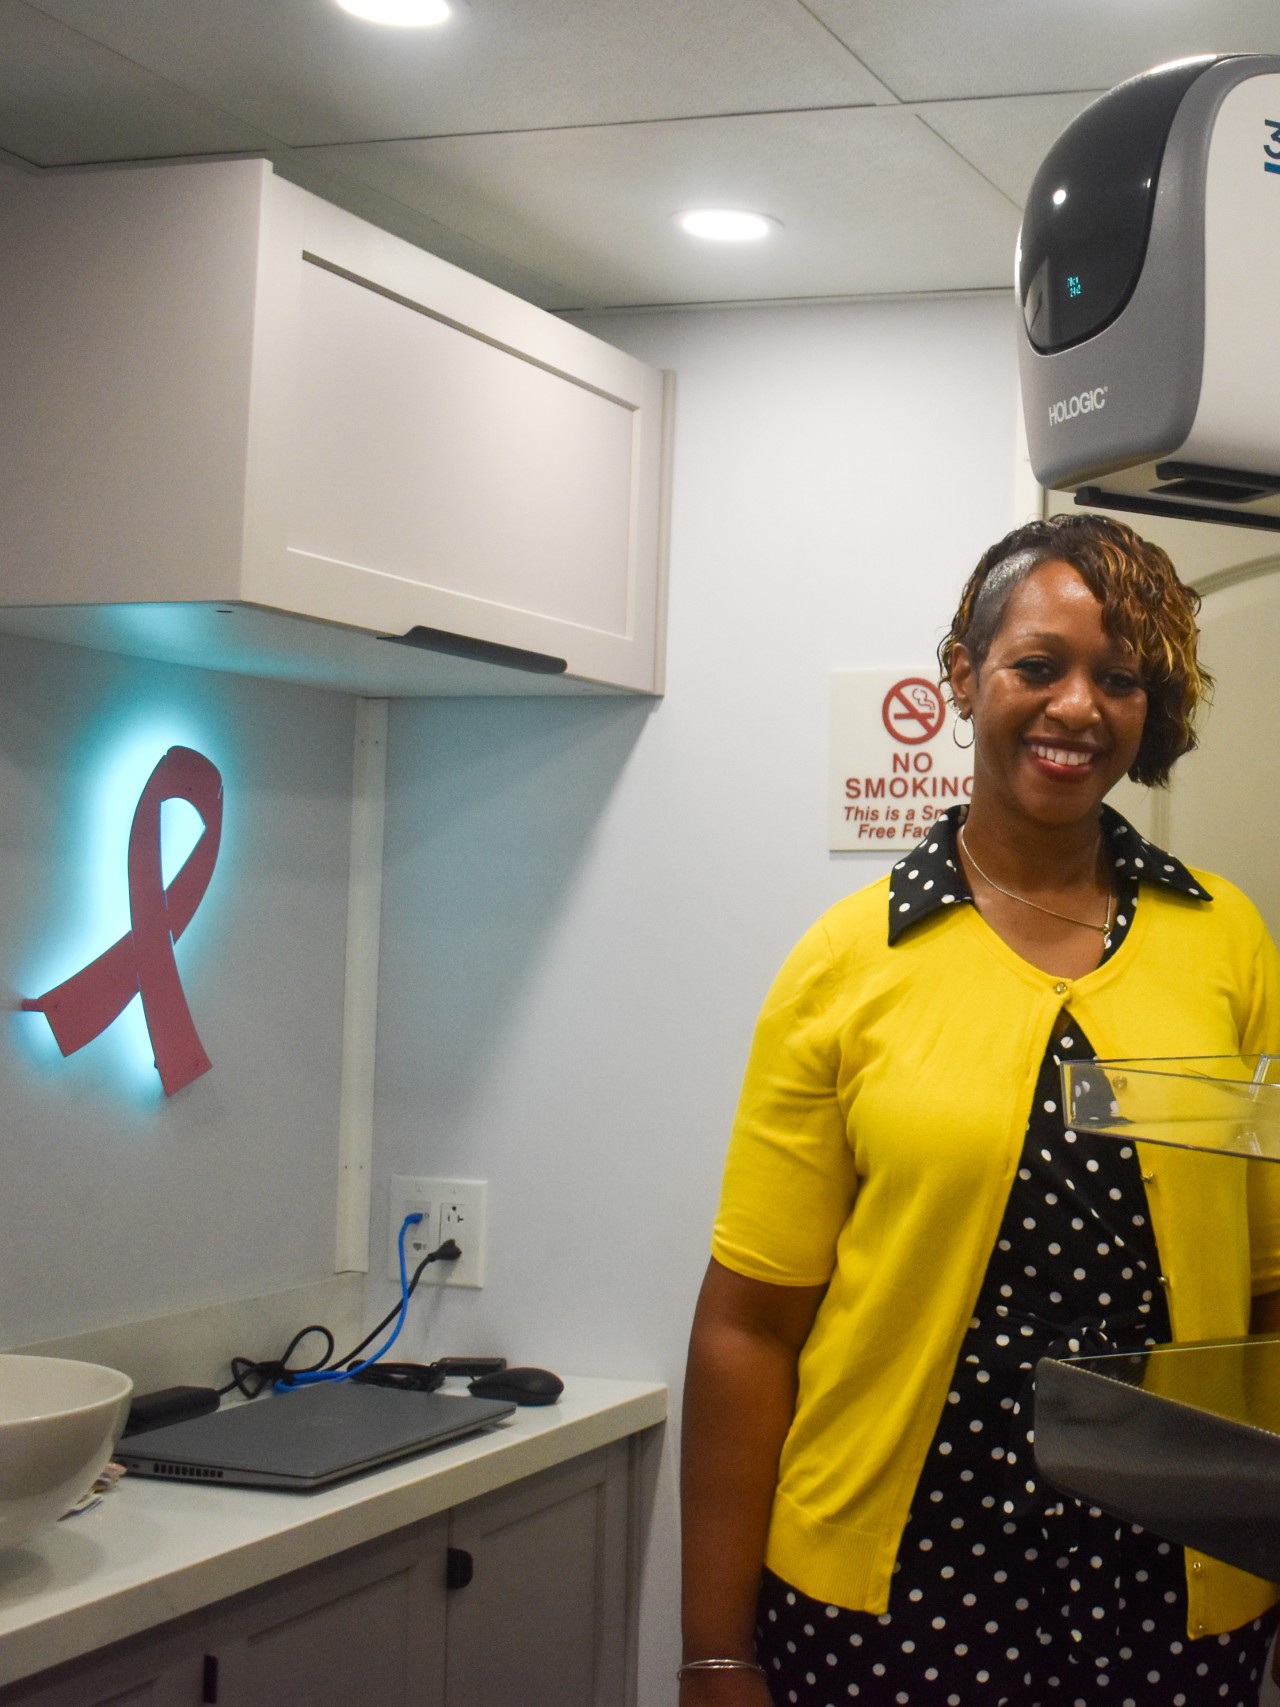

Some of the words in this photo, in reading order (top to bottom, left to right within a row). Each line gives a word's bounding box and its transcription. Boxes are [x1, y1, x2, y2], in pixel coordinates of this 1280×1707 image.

[1048, 387, 1106, 427] HOLOGIC
[892, 751, 933, 773] NO
[844, 805, 879, 821] This
[885, 805, 900, 821] is
[905, 808, 916, 821] a
[858, 823, 896, 838] Free
